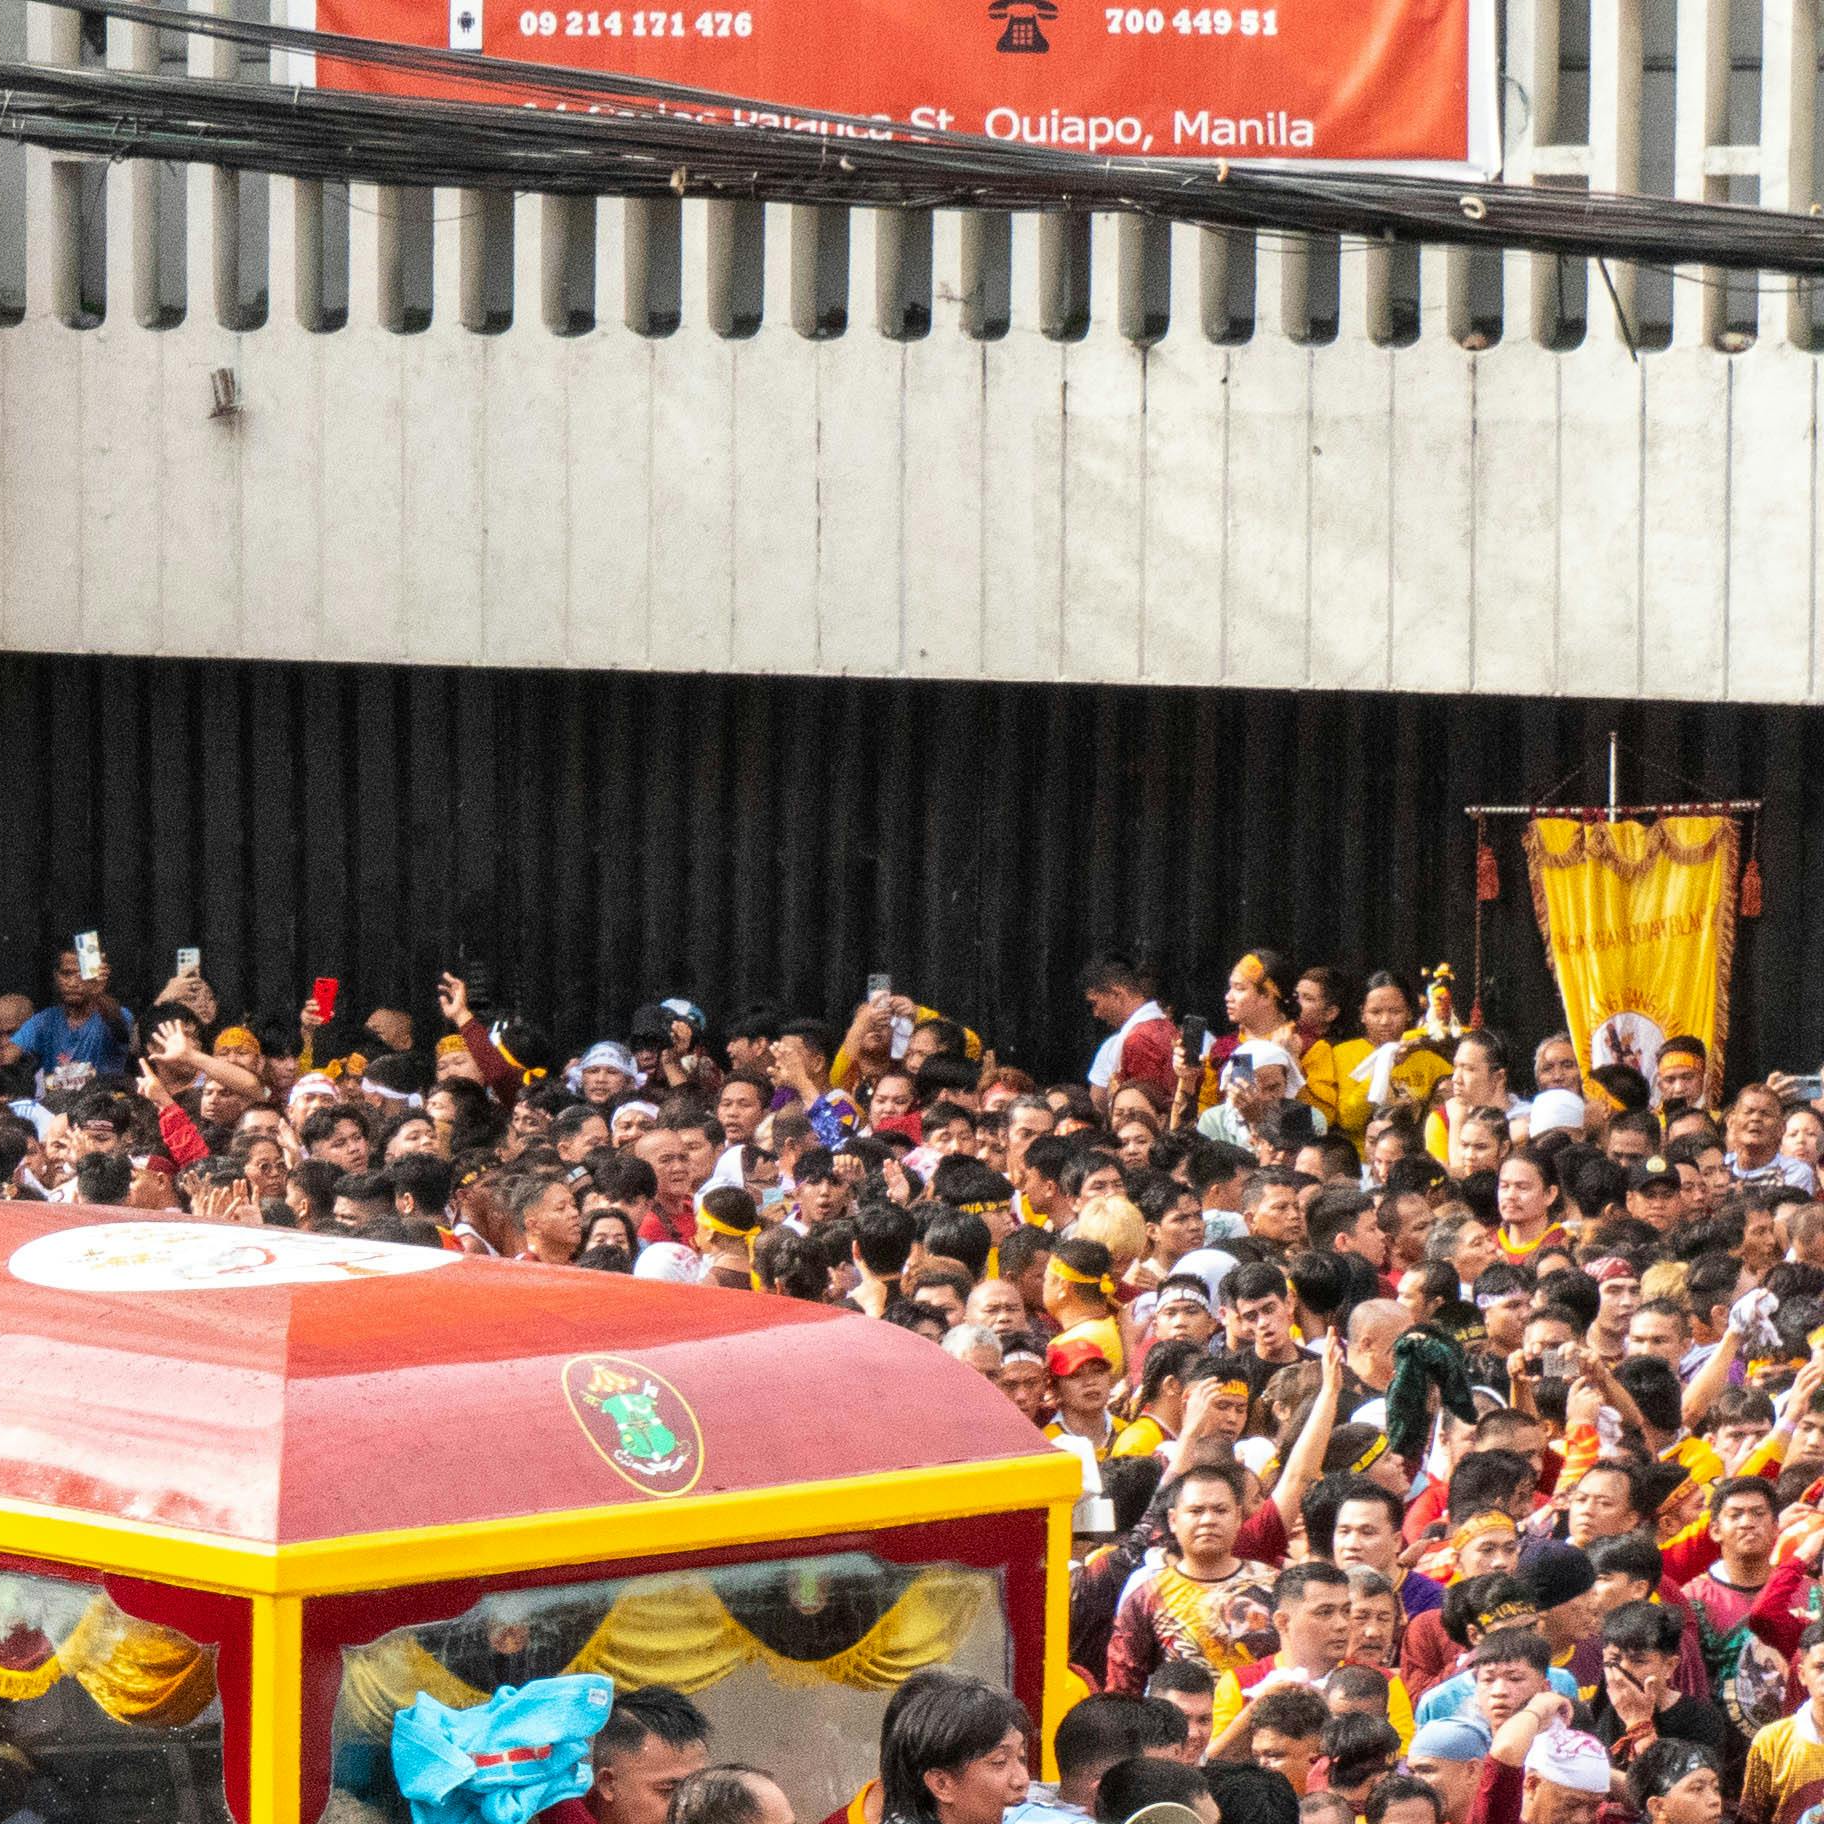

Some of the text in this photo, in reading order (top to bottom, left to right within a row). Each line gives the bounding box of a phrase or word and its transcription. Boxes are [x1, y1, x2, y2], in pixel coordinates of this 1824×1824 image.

[520, 12, 753, 36] 09 214 171 476
[1105, 9, 1279, 35] 700 449 51
[1174, 109, 1315, 148] Manila
